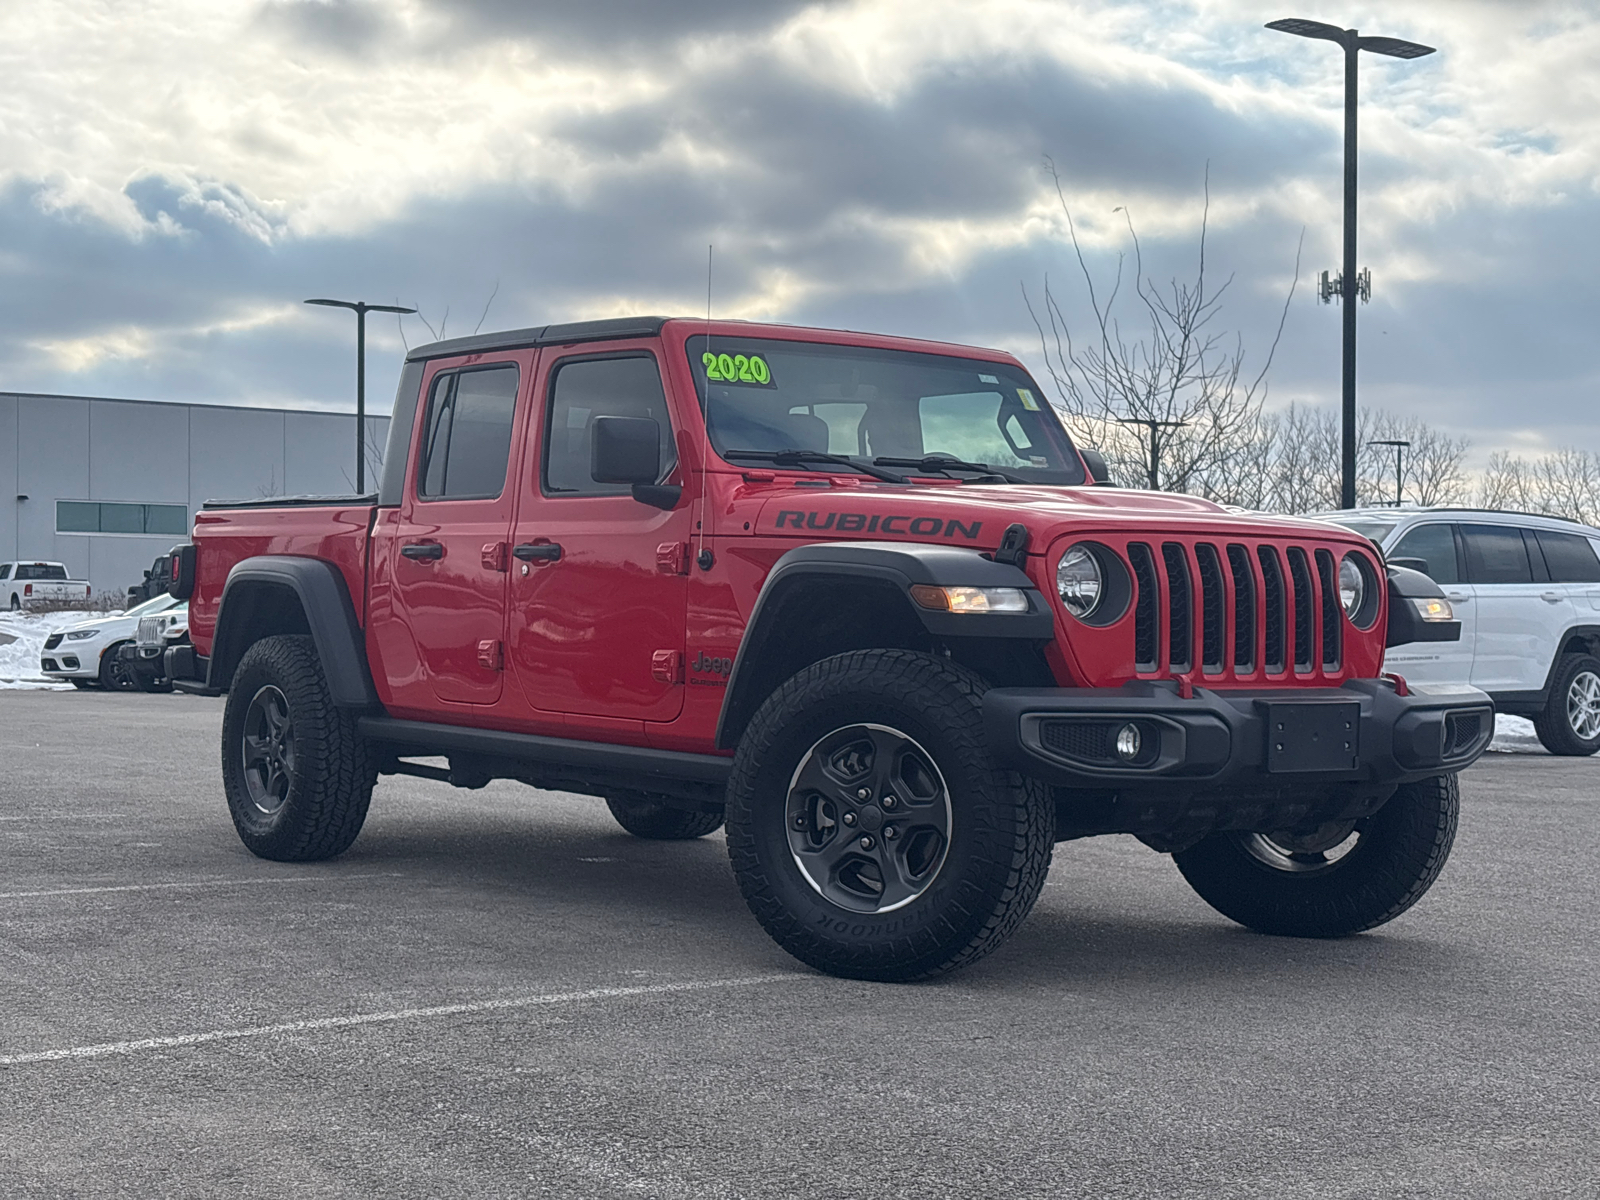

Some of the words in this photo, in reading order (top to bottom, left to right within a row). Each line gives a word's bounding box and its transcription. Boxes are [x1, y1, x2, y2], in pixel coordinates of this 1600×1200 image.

[703, 352, 770, 384] 2020
[775, 510, 983, 539] RUBICON
[691, 650, 732, 678] Jeep
